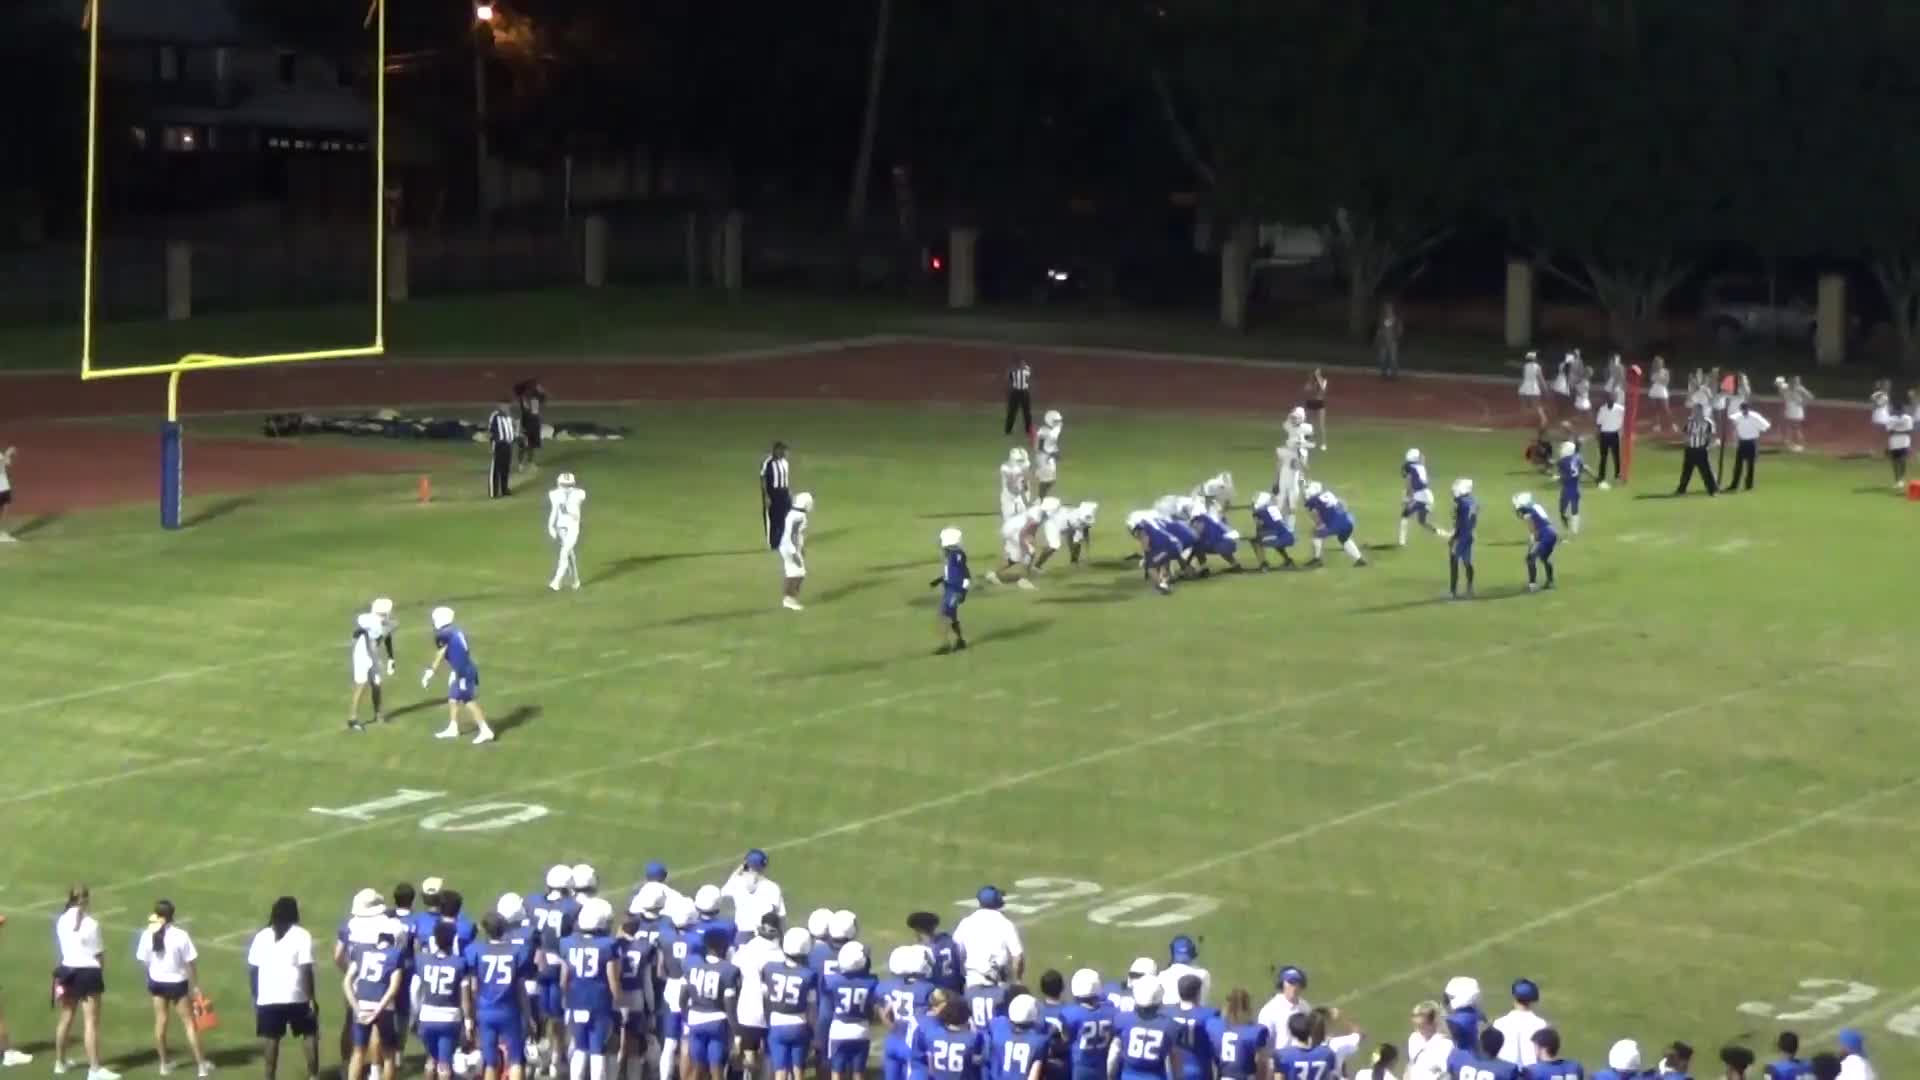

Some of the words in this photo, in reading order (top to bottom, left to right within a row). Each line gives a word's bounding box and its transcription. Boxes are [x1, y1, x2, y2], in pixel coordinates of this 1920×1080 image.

[309, 787, 548, 832] 10
[359, 951, 388, 982] 15
[481, 954, 513, 985] 75
[569, 947, 599, 978] 43
[423, 964, 455, 995] 42
[769, 973, 802, 1004] 35
[835, 987, 868, 1014] 39
[933, 1040, 966, 1072] 26
[1003, 1040, 1030, 1074] 19
[1127, 1026, 1164, 1060] 62
[1221, 1031, 1239, 1062] 6
